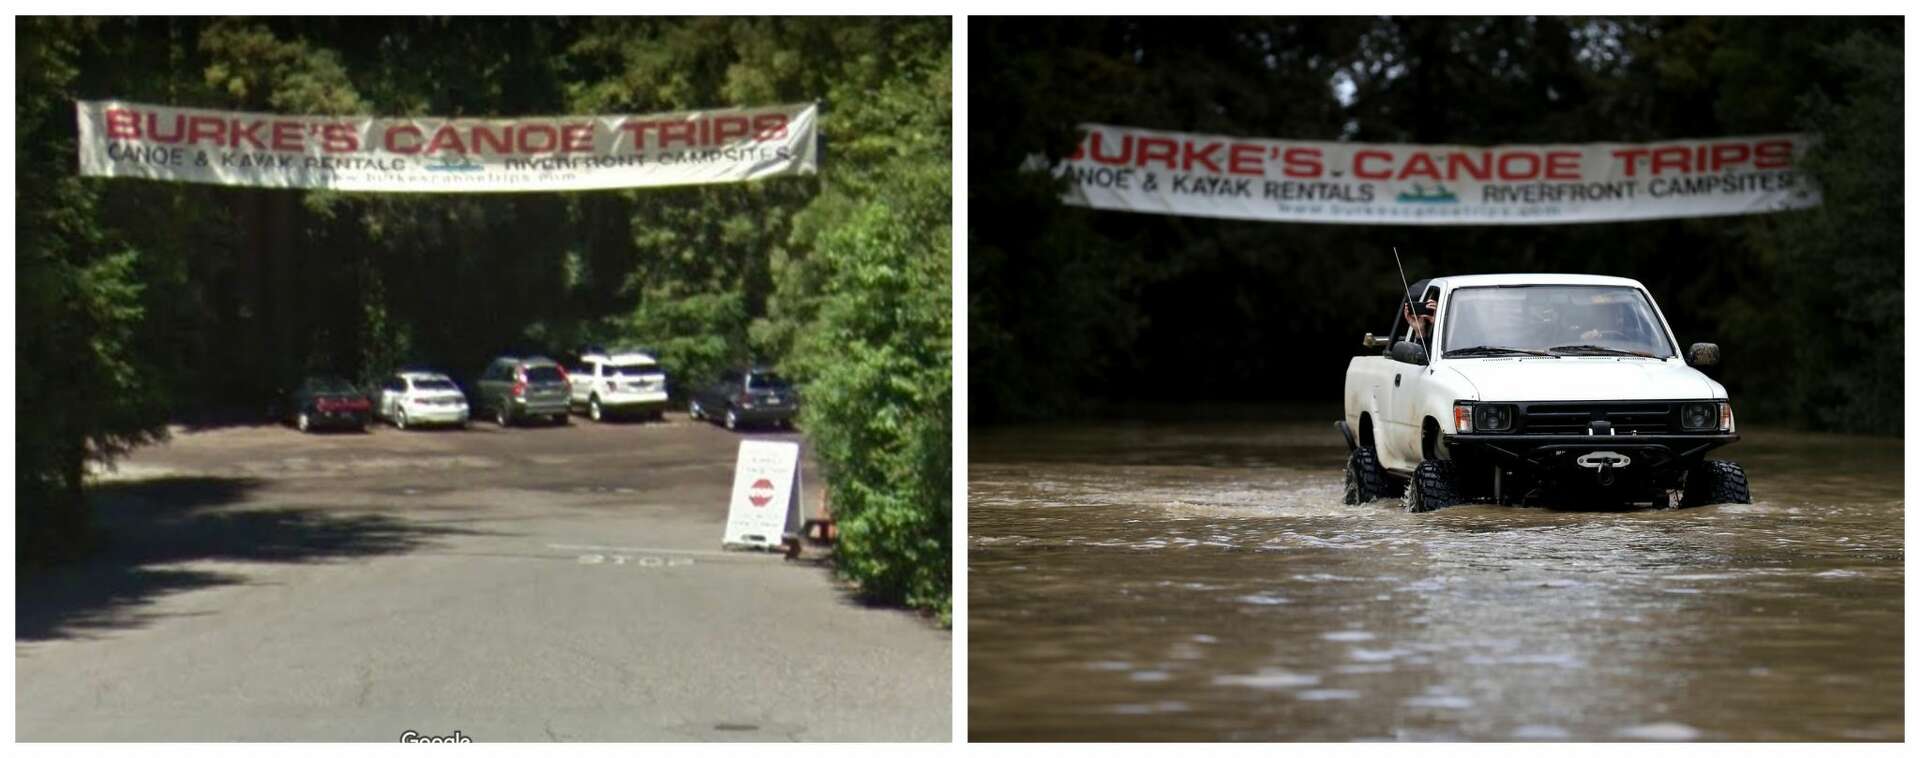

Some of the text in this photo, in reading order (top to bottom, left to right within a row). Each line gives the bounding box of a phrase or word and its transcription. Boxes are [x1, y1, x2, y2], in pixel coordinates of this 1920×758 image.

[105, 109, 789, 156] BURKE'S CANOE TRIPS
[108, 142, 183, 168] CANOE
[193, 152, 208, 168] &
[221, 151, 292, 170] KAYAK
[504, 154, 645, 171] RIVERFRONT
[659, 145, 791, 167] CAMPSITES
[1352, 149, 1583, 181] CANOE
[1611, 139, 1793, 177] TRIPS
[1062, 163, 1793, 205] ANOE & KAYAK RENTALS RIVERFRONT CAMPSITES
[577, 553, 695, 567] STOP
